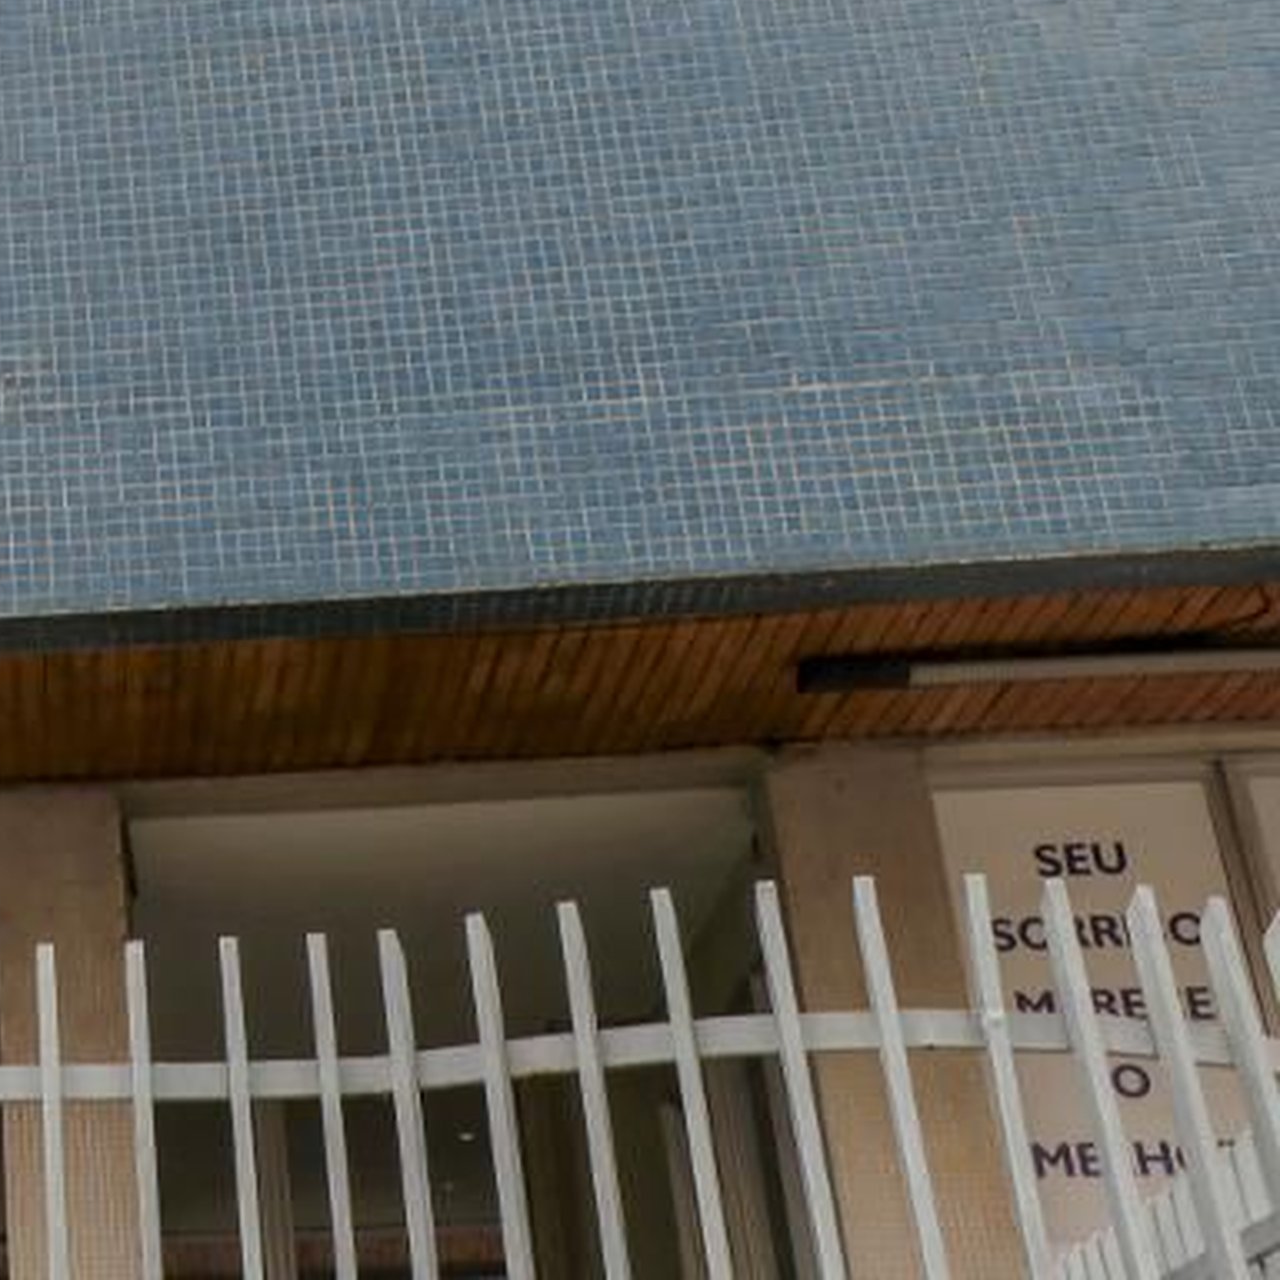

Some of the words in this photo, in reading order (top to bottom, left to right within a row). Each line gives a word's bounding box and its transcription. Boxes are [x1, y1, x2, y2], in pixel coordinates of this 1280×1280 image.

[1034, 841, 1127, 878] SEU
[991, 910, 1203, 953] SORIO
[1013, 985, 1218, 1021] MREE
[1111, 1063, 1151, 1098] O
